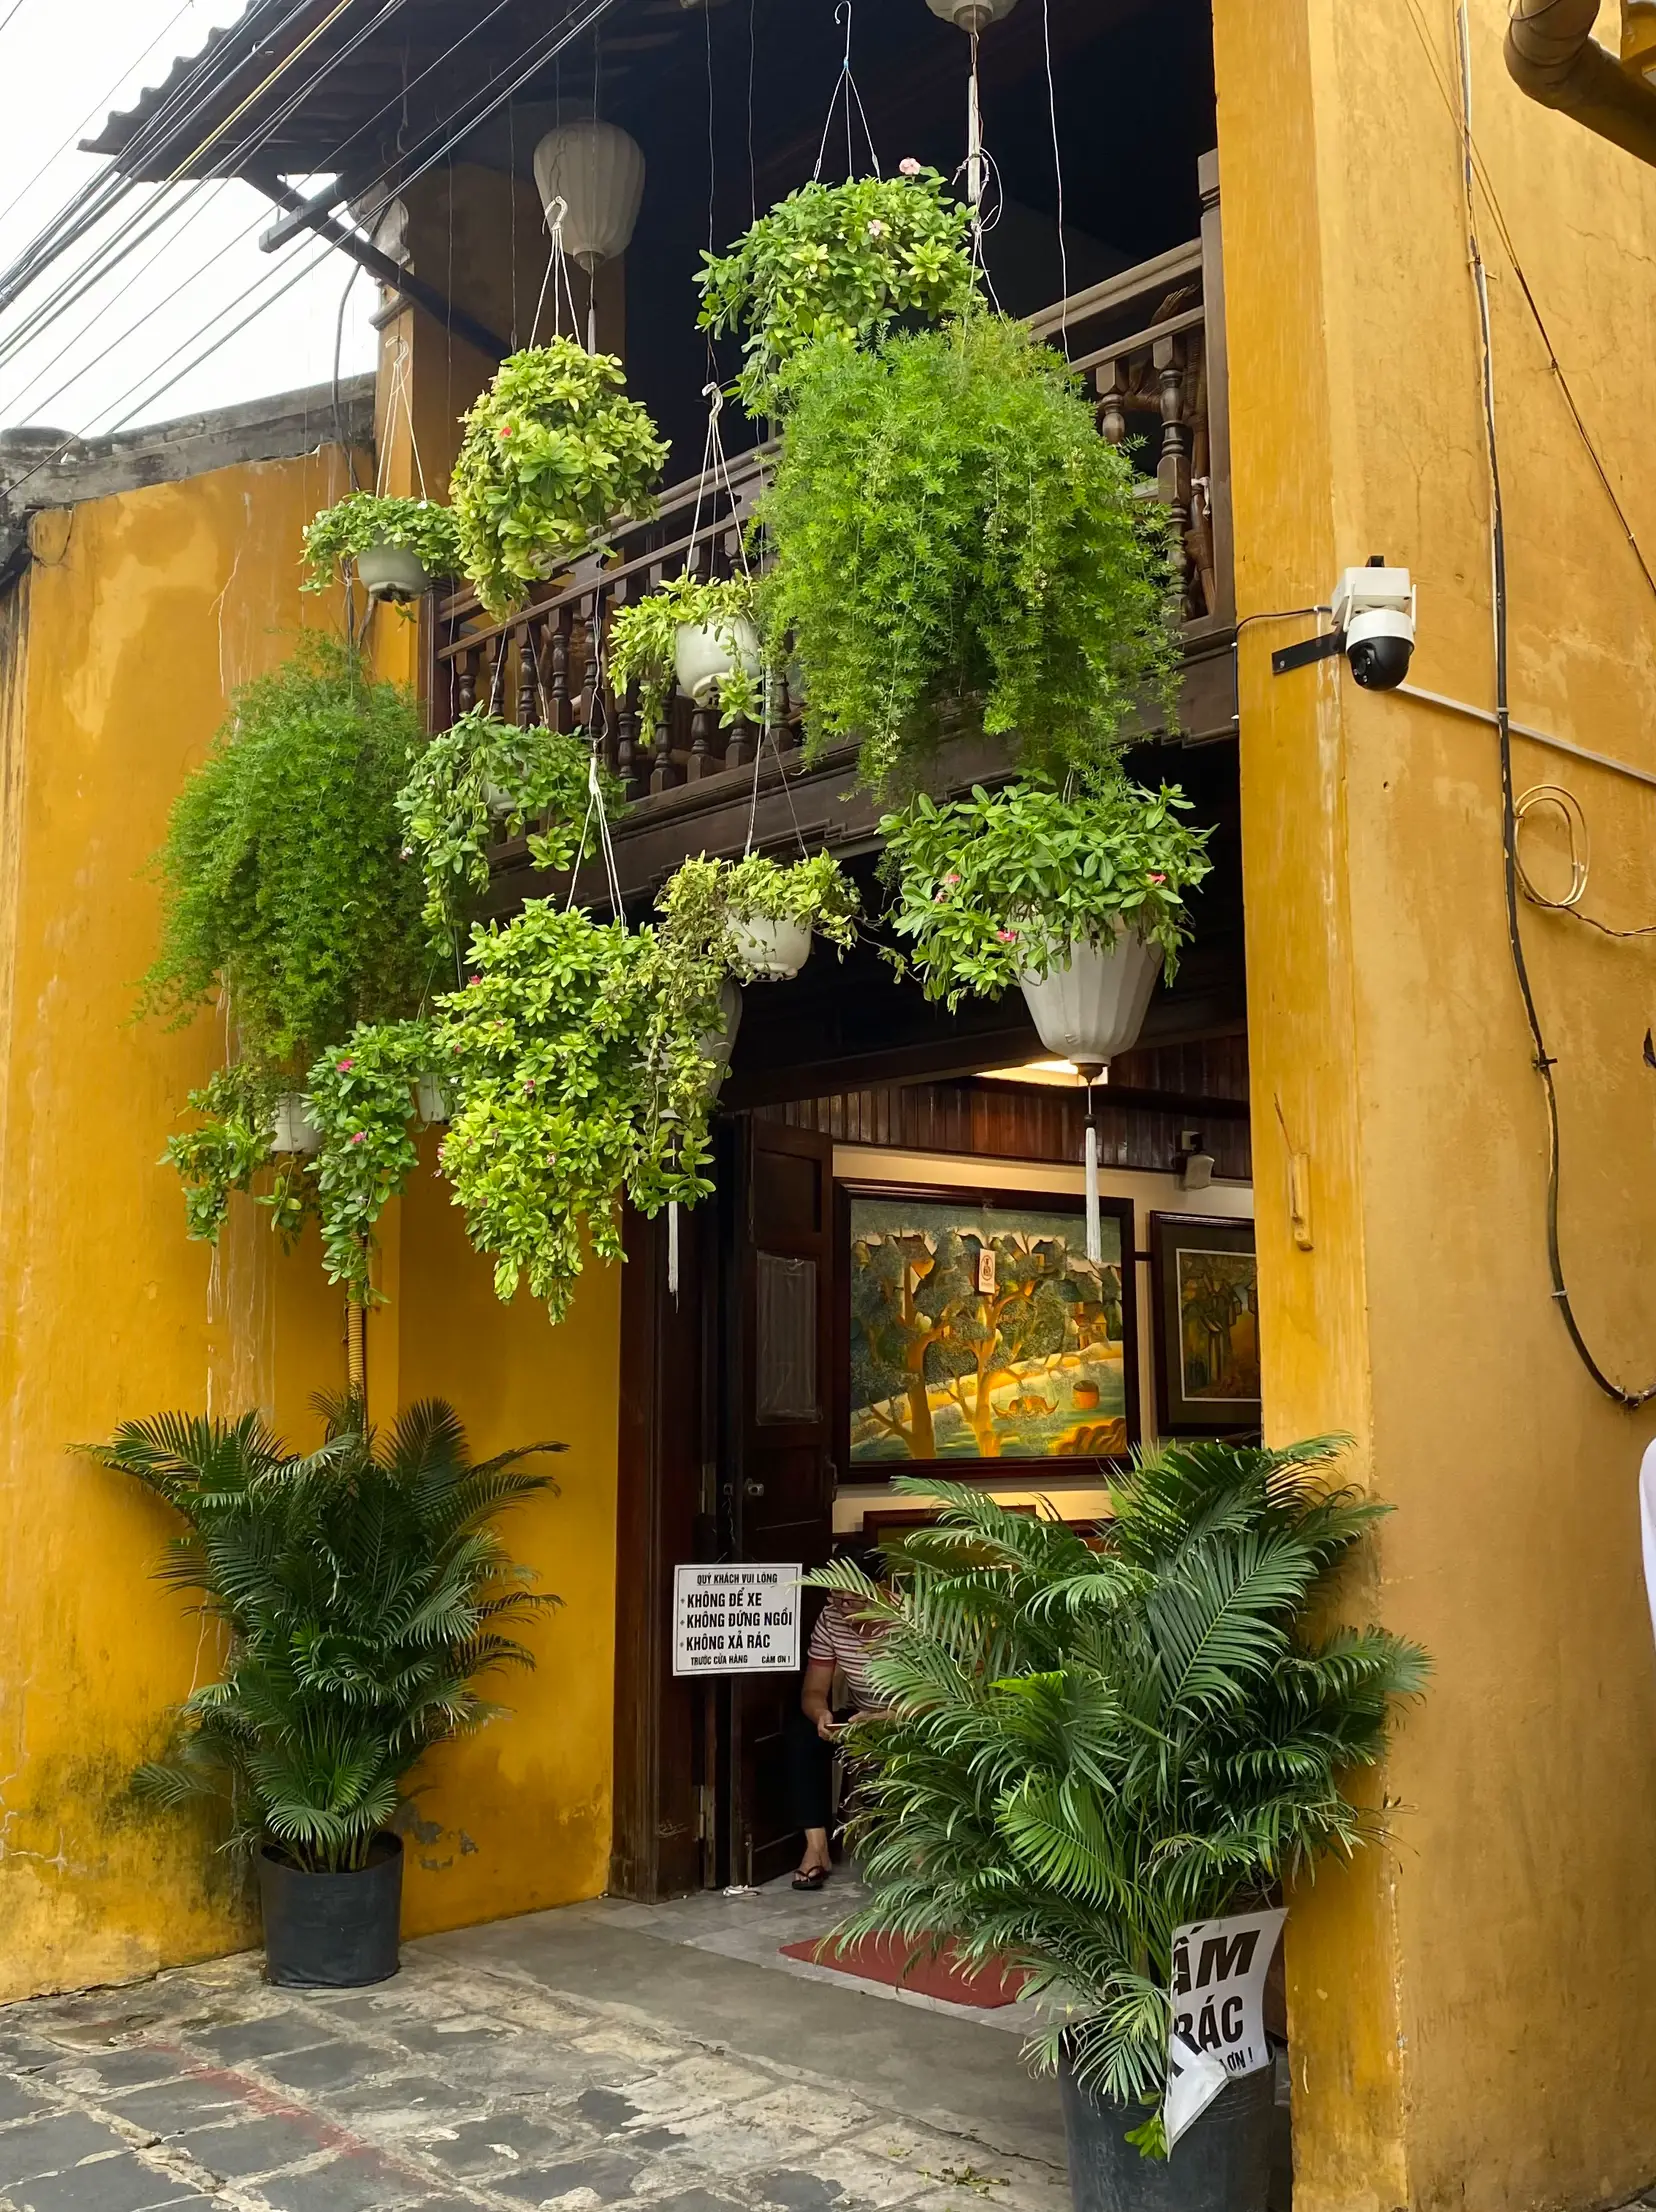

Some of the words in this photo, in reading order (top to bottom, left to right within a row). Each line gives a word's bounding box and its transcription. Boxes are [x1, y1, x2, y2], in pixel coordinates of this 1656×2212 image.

[697, 1572, 712, 1585] QUÝ
[714, 1572, 739, 1584] KHÁCH
[742, 1573, 754, 1583] VUI
[687, 1590, 725, 1608] KHÔNG
[729, 1587, 745, 1606] ĐỂ
[747, 1592, 762, 1606] XE
[687, 1611, 725, 1628] KHÔNG
[728, 1610, 760, 1627] ĐỨNG
[764, 1607, 792, 1626] NGỒI
[686, 1633, 724, 1651] KHÔNG
[728, 1630, 743, 1649] XẢ
[747, 1631, 770, 1649] RÁC
[729, 1653, 748, 1664] HÀNG
[1173, 1994, 1244, 2056] RÁC
